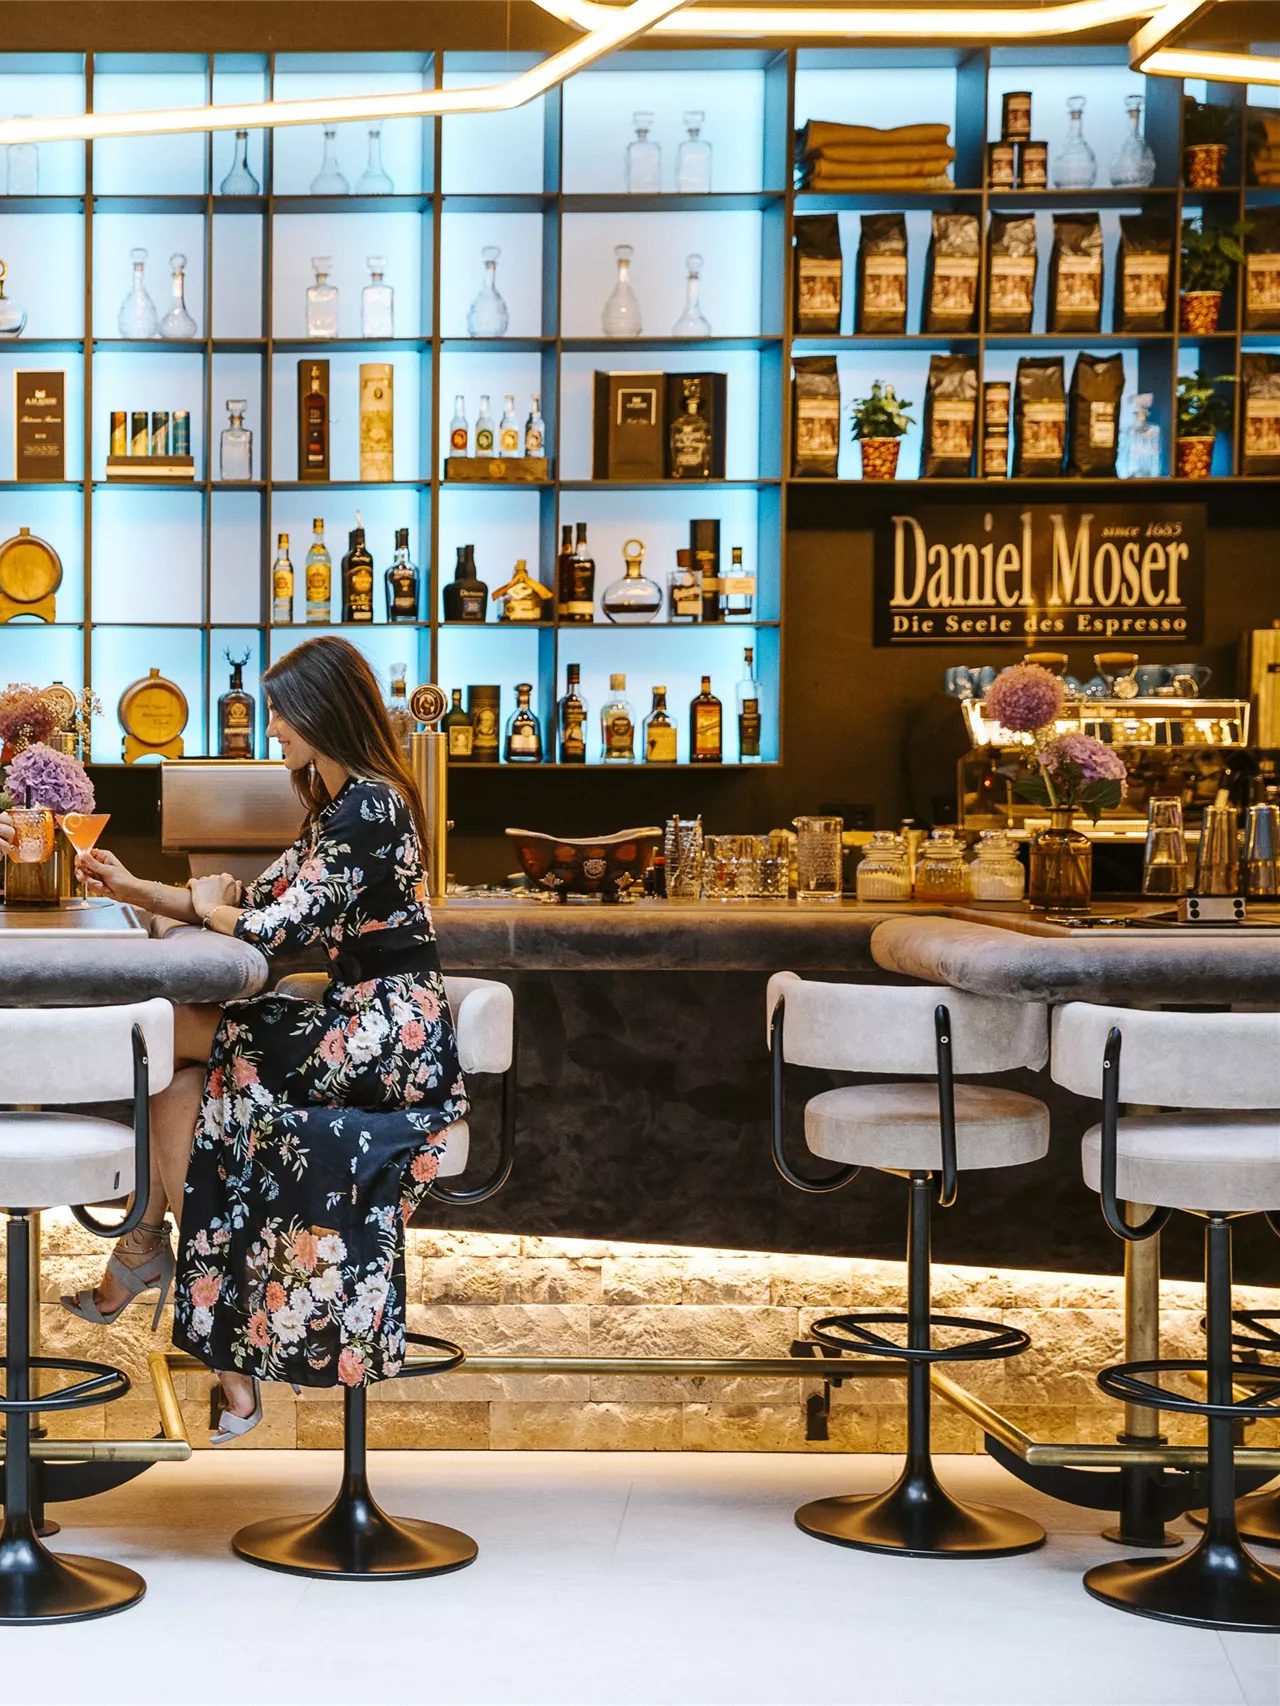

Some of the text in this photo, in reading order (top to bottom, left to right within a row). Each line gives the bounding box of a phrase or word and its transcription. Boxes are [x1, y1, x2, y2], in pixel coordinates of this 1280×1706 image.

[1101, 523, 1140, 537] since
[890, 511, 1190, 608] Daniel Moser
[892, 614, 1188, 637] Die Seele des Espresso
